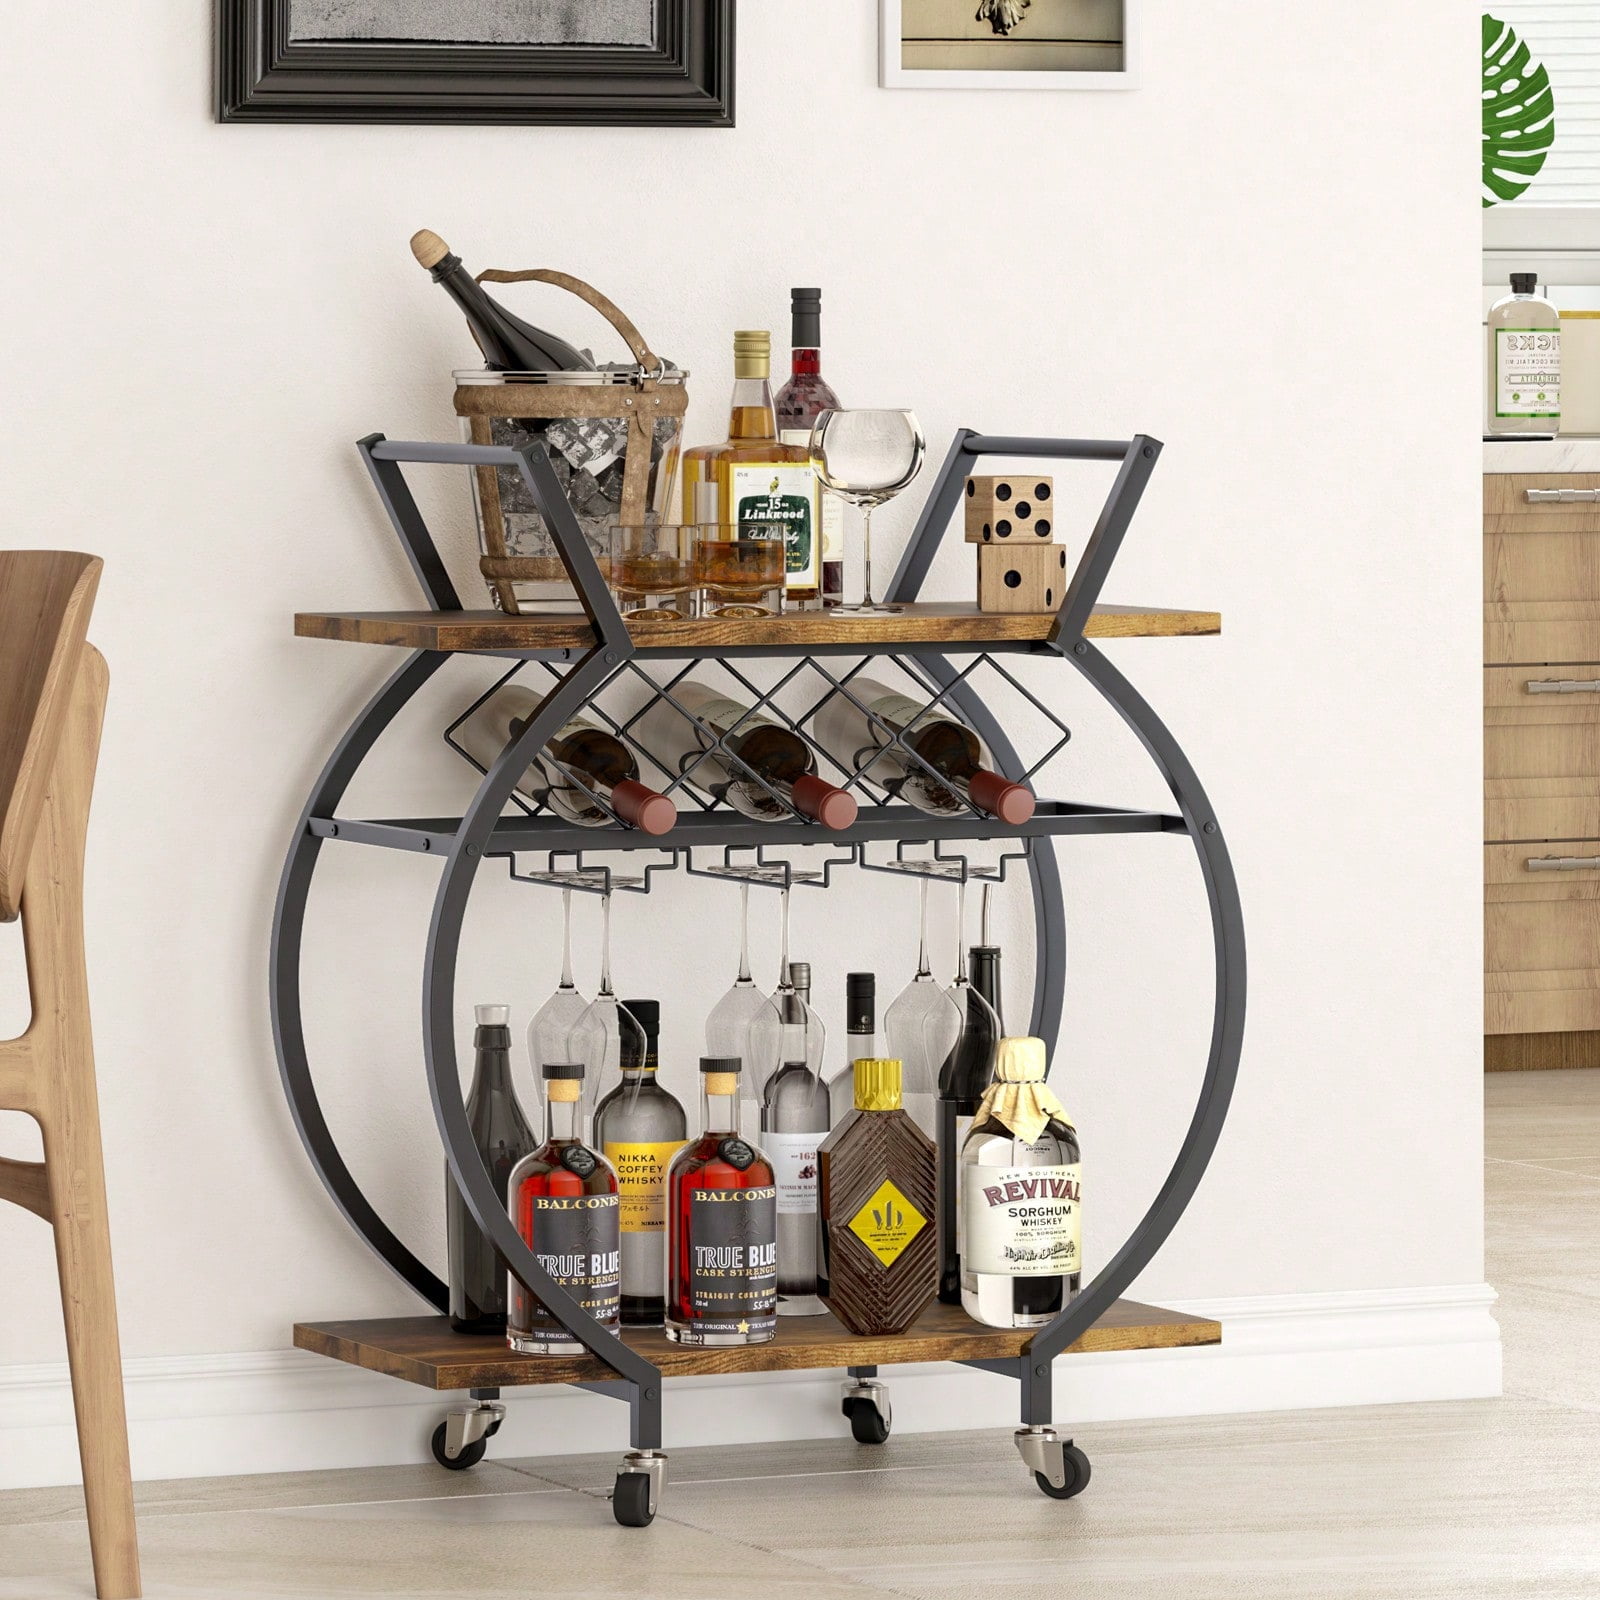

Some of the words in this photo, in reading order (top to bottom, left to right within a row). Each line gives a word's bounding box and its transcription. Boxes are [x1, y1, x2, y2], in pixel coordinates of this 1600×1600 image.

[768, 498, 782, 510] 15
[743, 509, 805, 520] Linkwood
[618, 1154, 656, 1162] NIKKA
[618, 1165, 663, 1173] COFFEY
[618, 1176, 664, 1185] WHISKY
[983, 1178, 1080, 1207] REVIVAL
[1008, 1205, 1072, 1218] SORGHUM
[1021, 1218, 1063, 1227] WHISKEY
[695, 1246, 743, 1269] TRUE
[749, 1242, 776, 1267] BLUE
[537, 1254, 586, 1277] TRUE
[591, 1251, 619, 1276] BLUE
[695, 1269, 725, 1277] CASK
